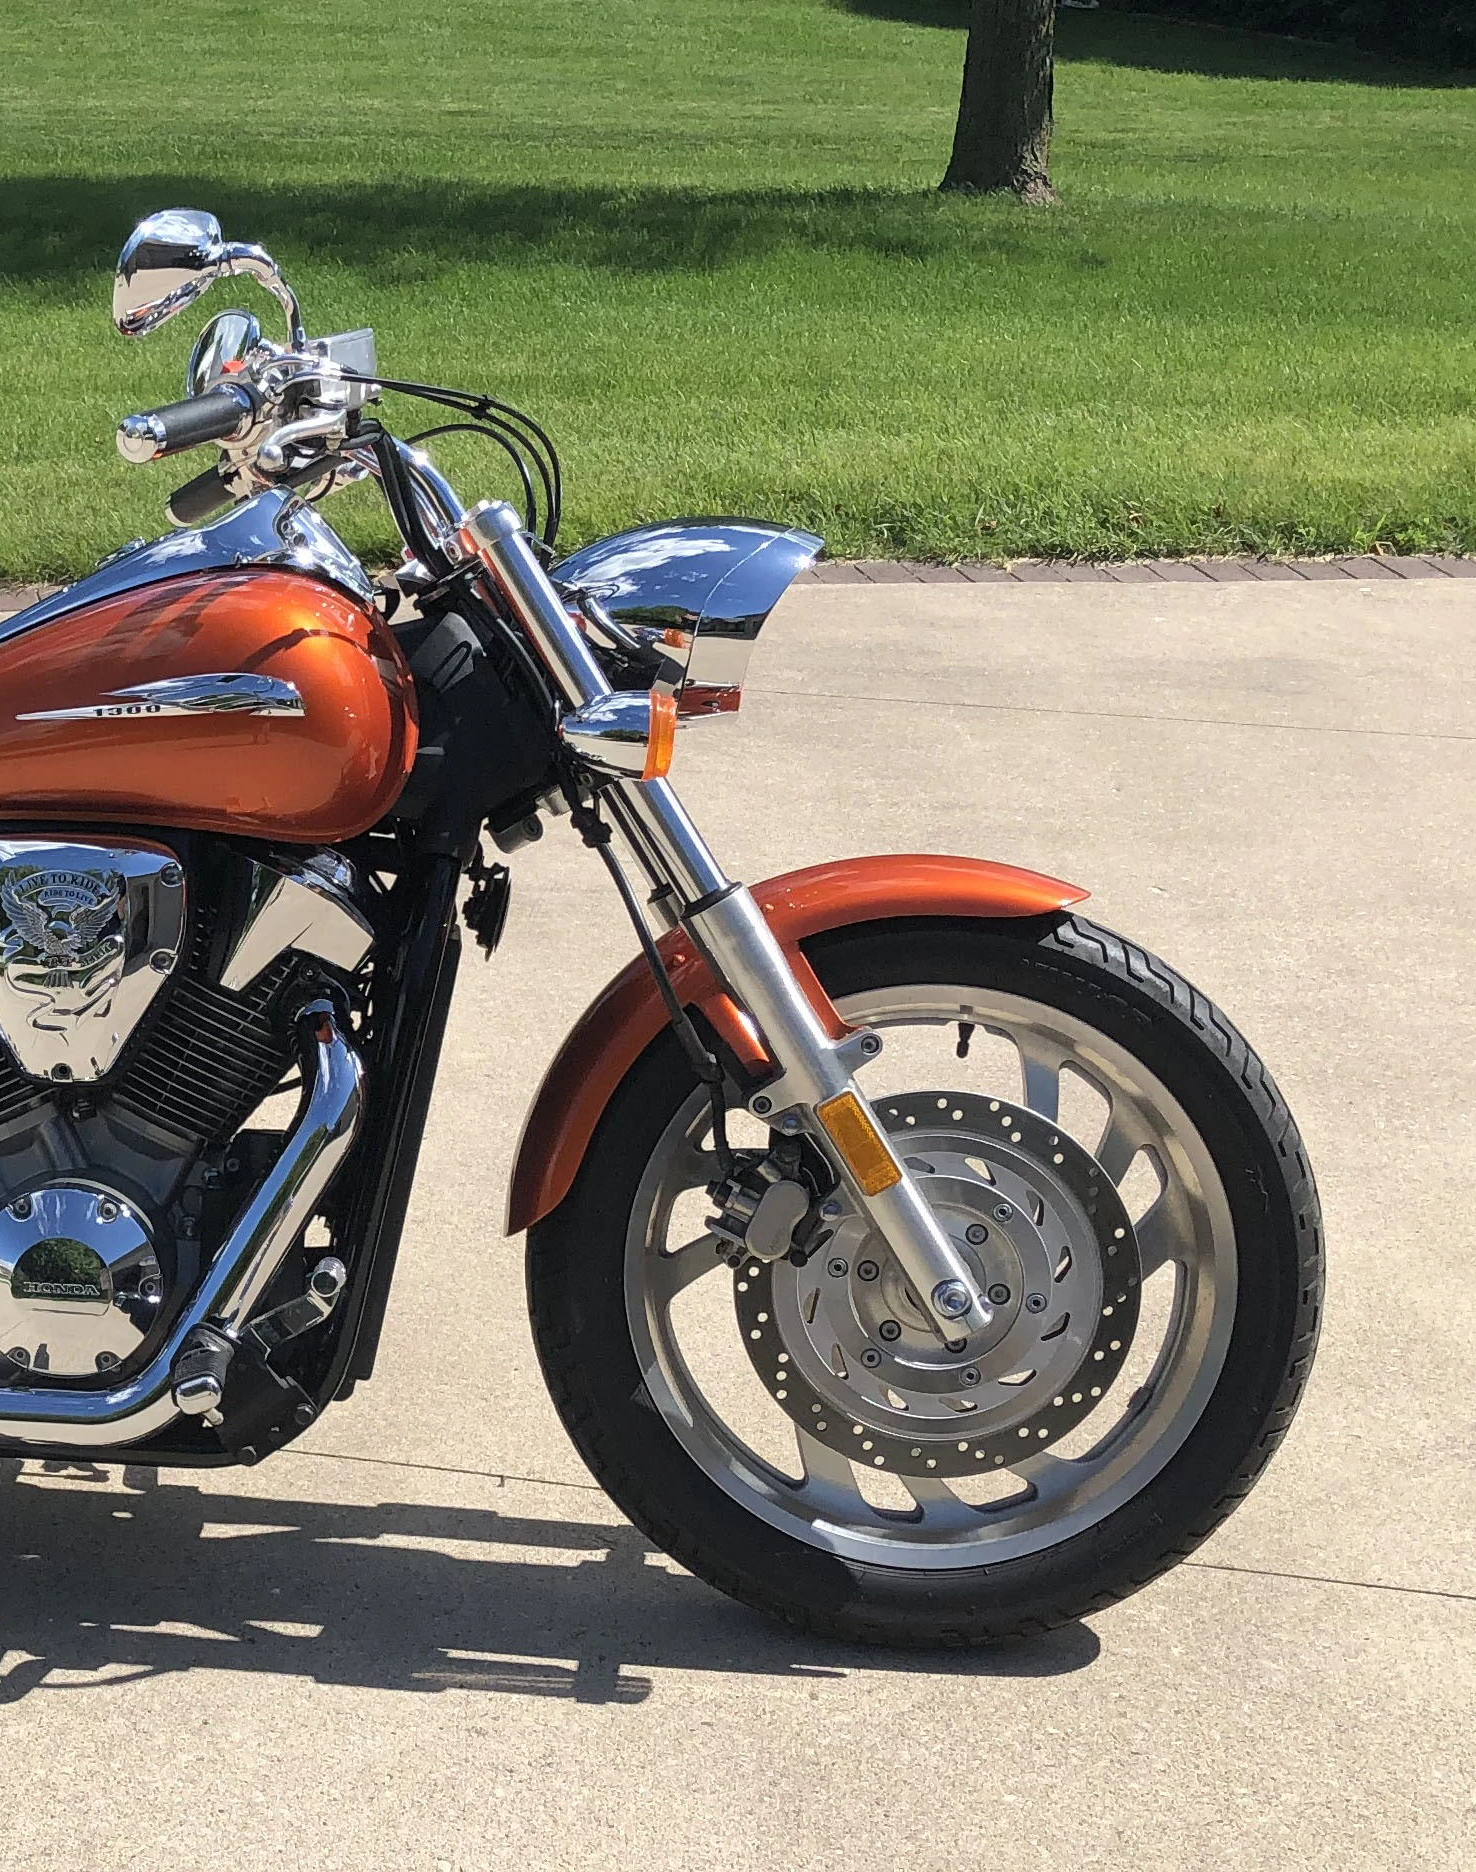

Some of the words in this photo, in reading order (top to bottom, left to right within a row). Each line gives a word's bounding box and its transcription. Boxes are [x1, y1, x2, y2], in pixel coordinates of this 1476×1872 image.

[93, 705, 161, 716] 1300
[19, 875, 48, 892] LIVE
[51, 873, 67, 884] TO
[71, 874, 101, 894] RIDE
[43, 889, 63, 898] RIDE
[64, 889, 75, 898] TO
[75, 891, 93, 905] LIVE
[23, 1281, 100, 1296] HONDA
